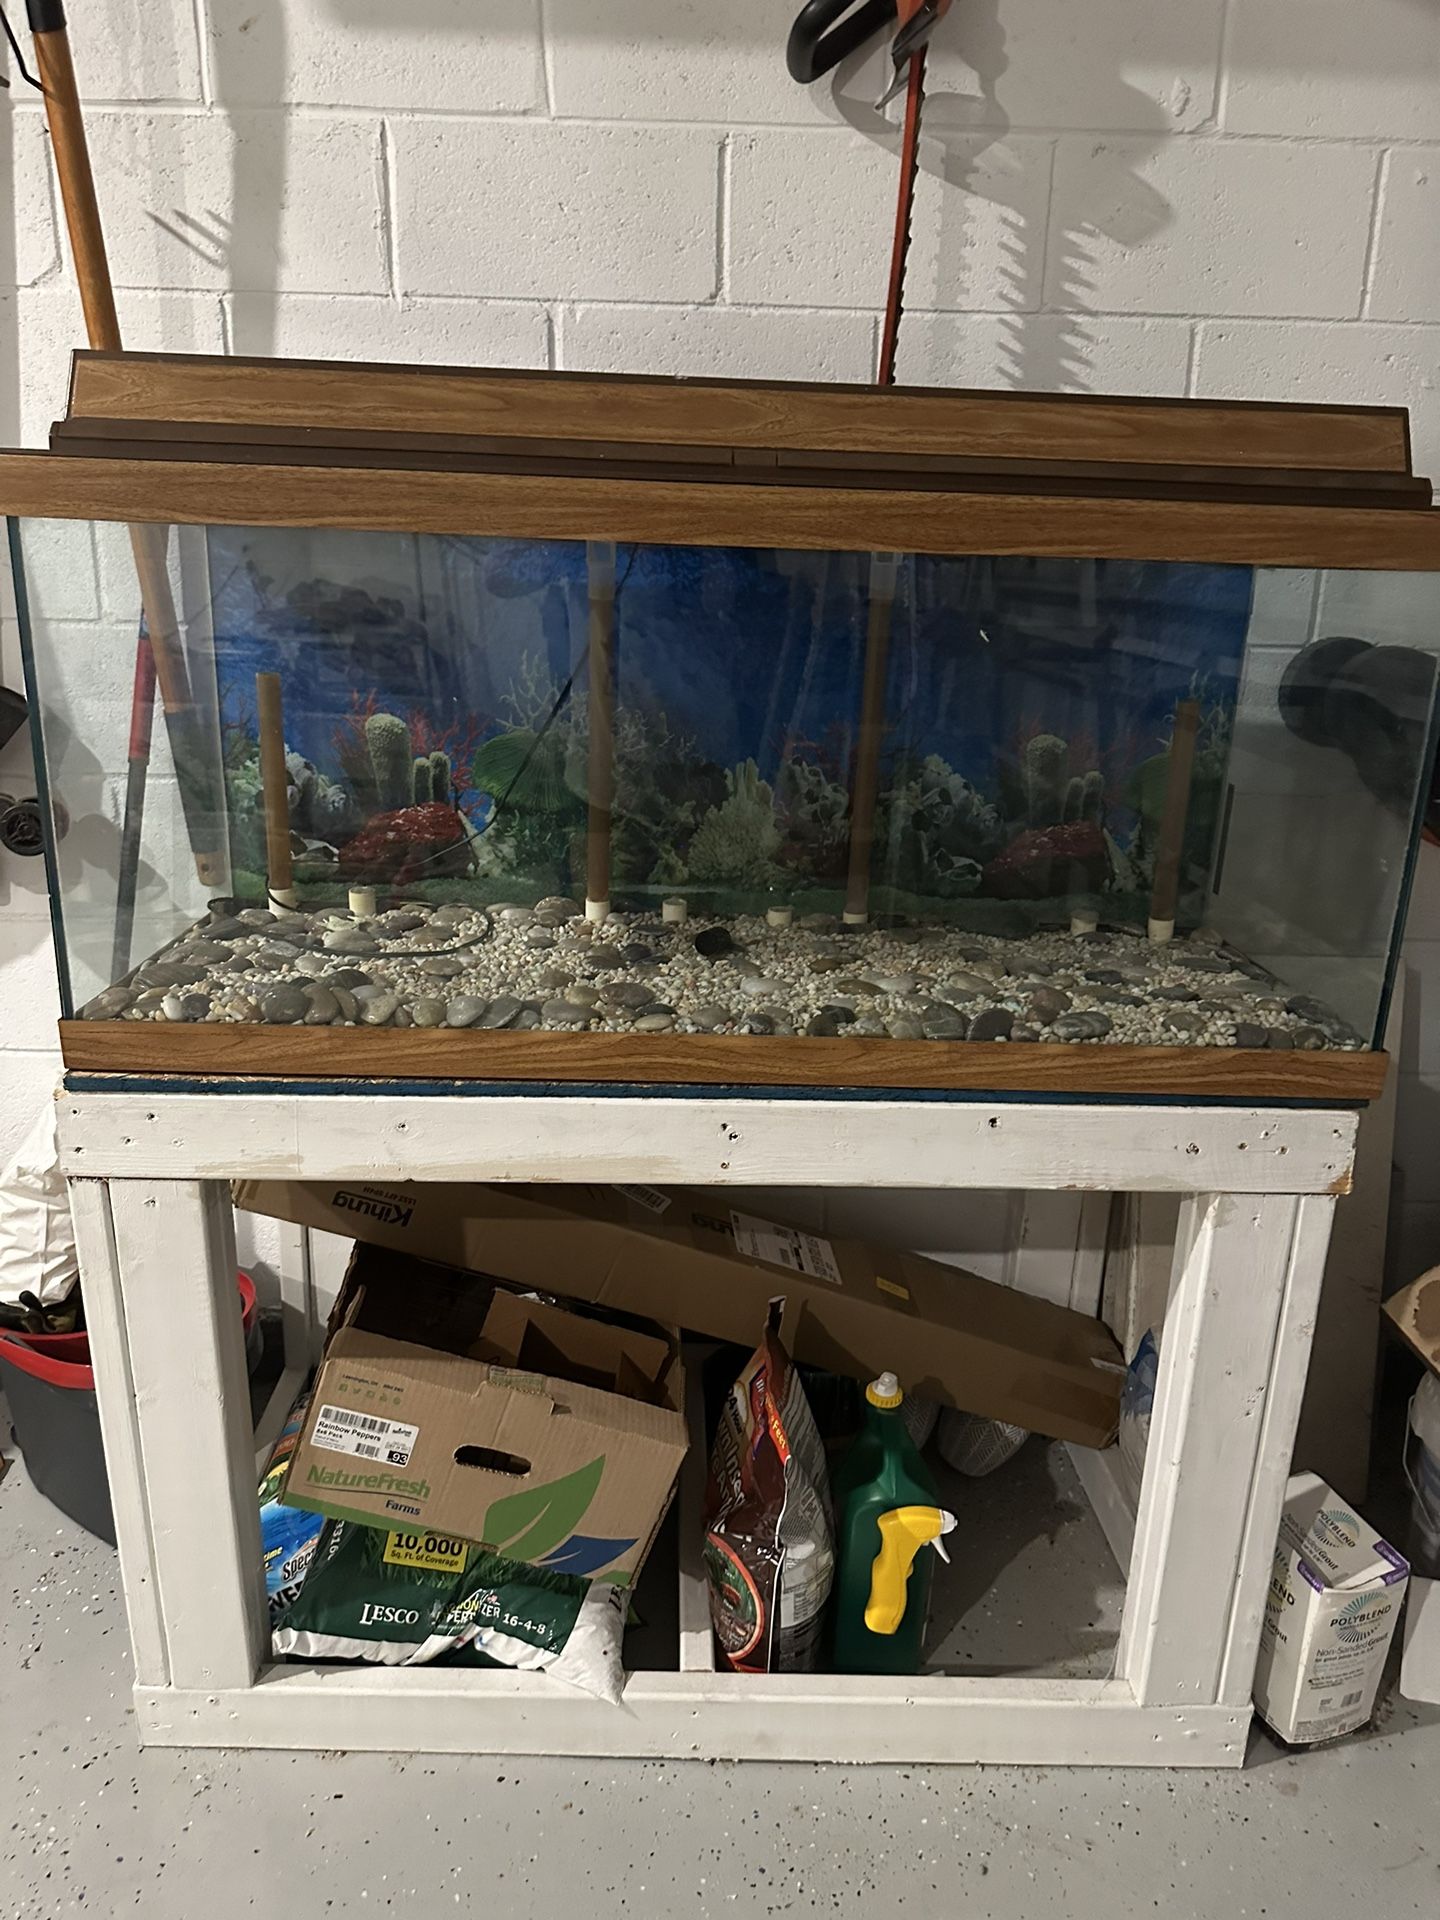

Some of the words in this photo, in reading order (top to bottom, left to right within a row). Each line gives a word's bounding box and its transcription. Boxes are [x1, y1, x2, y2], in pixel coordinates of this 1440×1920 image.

[332, 1190, 413, 1228] Kihung
[318, 1421, 351, 1435] Rainbow
[351, 1428, 382, 1443] Peppers
[392, 1452, 408, 1465] 93
[306, 1463, 432, 1499] NatureFresh
[385, 1499, 421, 1516] Farms
[1317, 1509, 1357, 1549] POLYBLEND
[393, 1532, 463, 1557] 10,000
[390, 1549, 403, 1560] Sq.
[415, 1553, 425, 1562] of
[424, 1554, 459, 1567] Coverage
[1317, 1547, 1340, 1572] Grout
[359, 1603, 420, 1626] LESCO
[502, 1613, 547, 1635] 16-4-8
[1329, 1604, 1392, 1628] POLYBLEND
[1316, 1638, 1369, 1657] Non-Sanded
[1367, 1631, 1389, 1647] Grout
